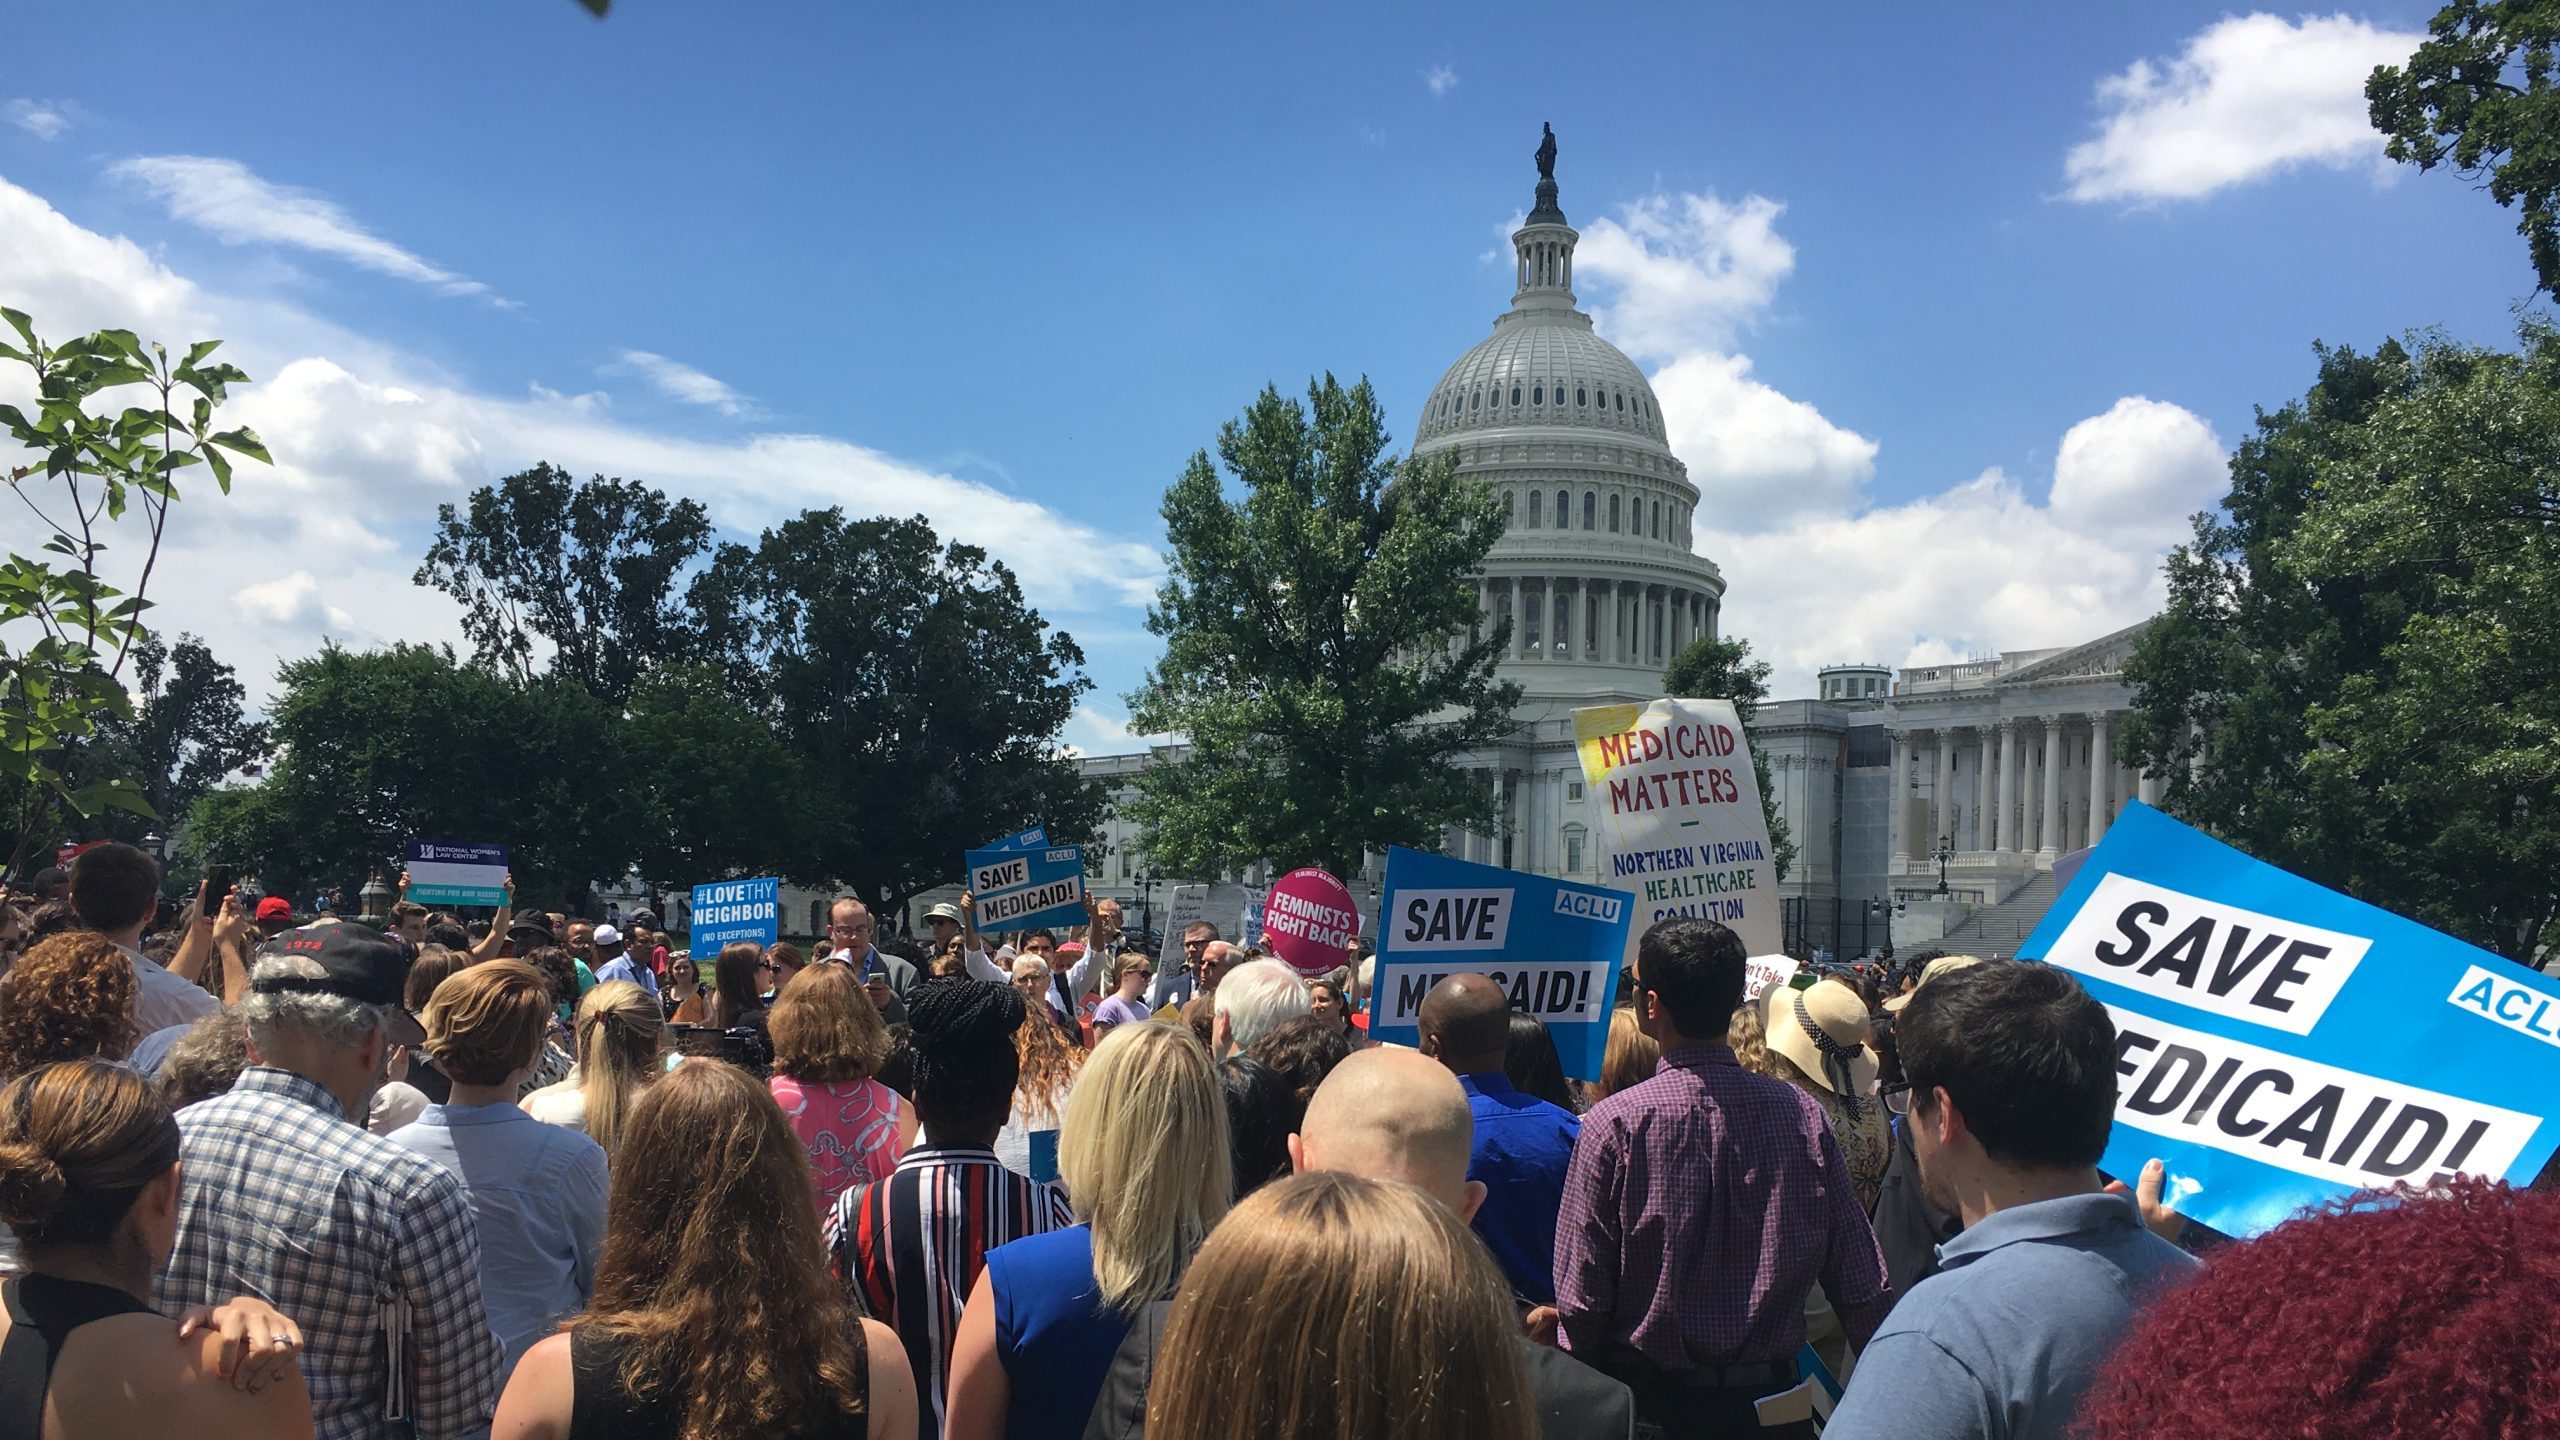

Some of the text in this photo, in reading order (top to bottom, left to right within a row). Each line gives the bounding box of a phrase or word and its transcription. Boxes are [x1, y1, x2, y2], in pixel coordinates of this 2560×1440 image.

[1599, 724, 1734, 768] MEDICAID
[1609, 768, 1738, 814] MATTERS
[436, 846, 501, 856] NATIONAL WOMEN'S
[1022, 831, 1041, 844] ACLU
[1048, 850, 1074, 861] ACLU
[1613, 840, 1764, 877] NORTHERN VIRGINIA
[980, 862, 1024, 890] SAVE
[1295, 870, 1342, 891] FEMINIST MAJORITY
[1645, 868, 1756, 901] HEALTHCARE
[416, 888, 446, 896] FIGHTING
[447, 889, 460, 897] FOR
[477, 891, 501, 899] RIGHTS
[696, 881, 773, 905] #LOVETHY
[984, 881, 1074, 921] MEDICAID!
[1558, 893, 1617, 919] ACLU
[693, 902, 775, 926] NEIGHBOR
[1273, 891, 1350, 930] FEMINISTS
[1404, 897, 1500, 943] SAVE
[702, 928, 766, 943] (NO EXCEPTIONS)
[1266, 909, 1308, 938] FIGHT
[1308, 923, 1352, 950] BACK
[2095, 900, 2332, 1013] SAVE
[1761, 966, 1784, 984] Take
[1396, 970, 1591, 1018] MAID!
[2458, 977, 2560, 1040] ACL
[2116, 1029, 2491, 1184] EDICAID!
